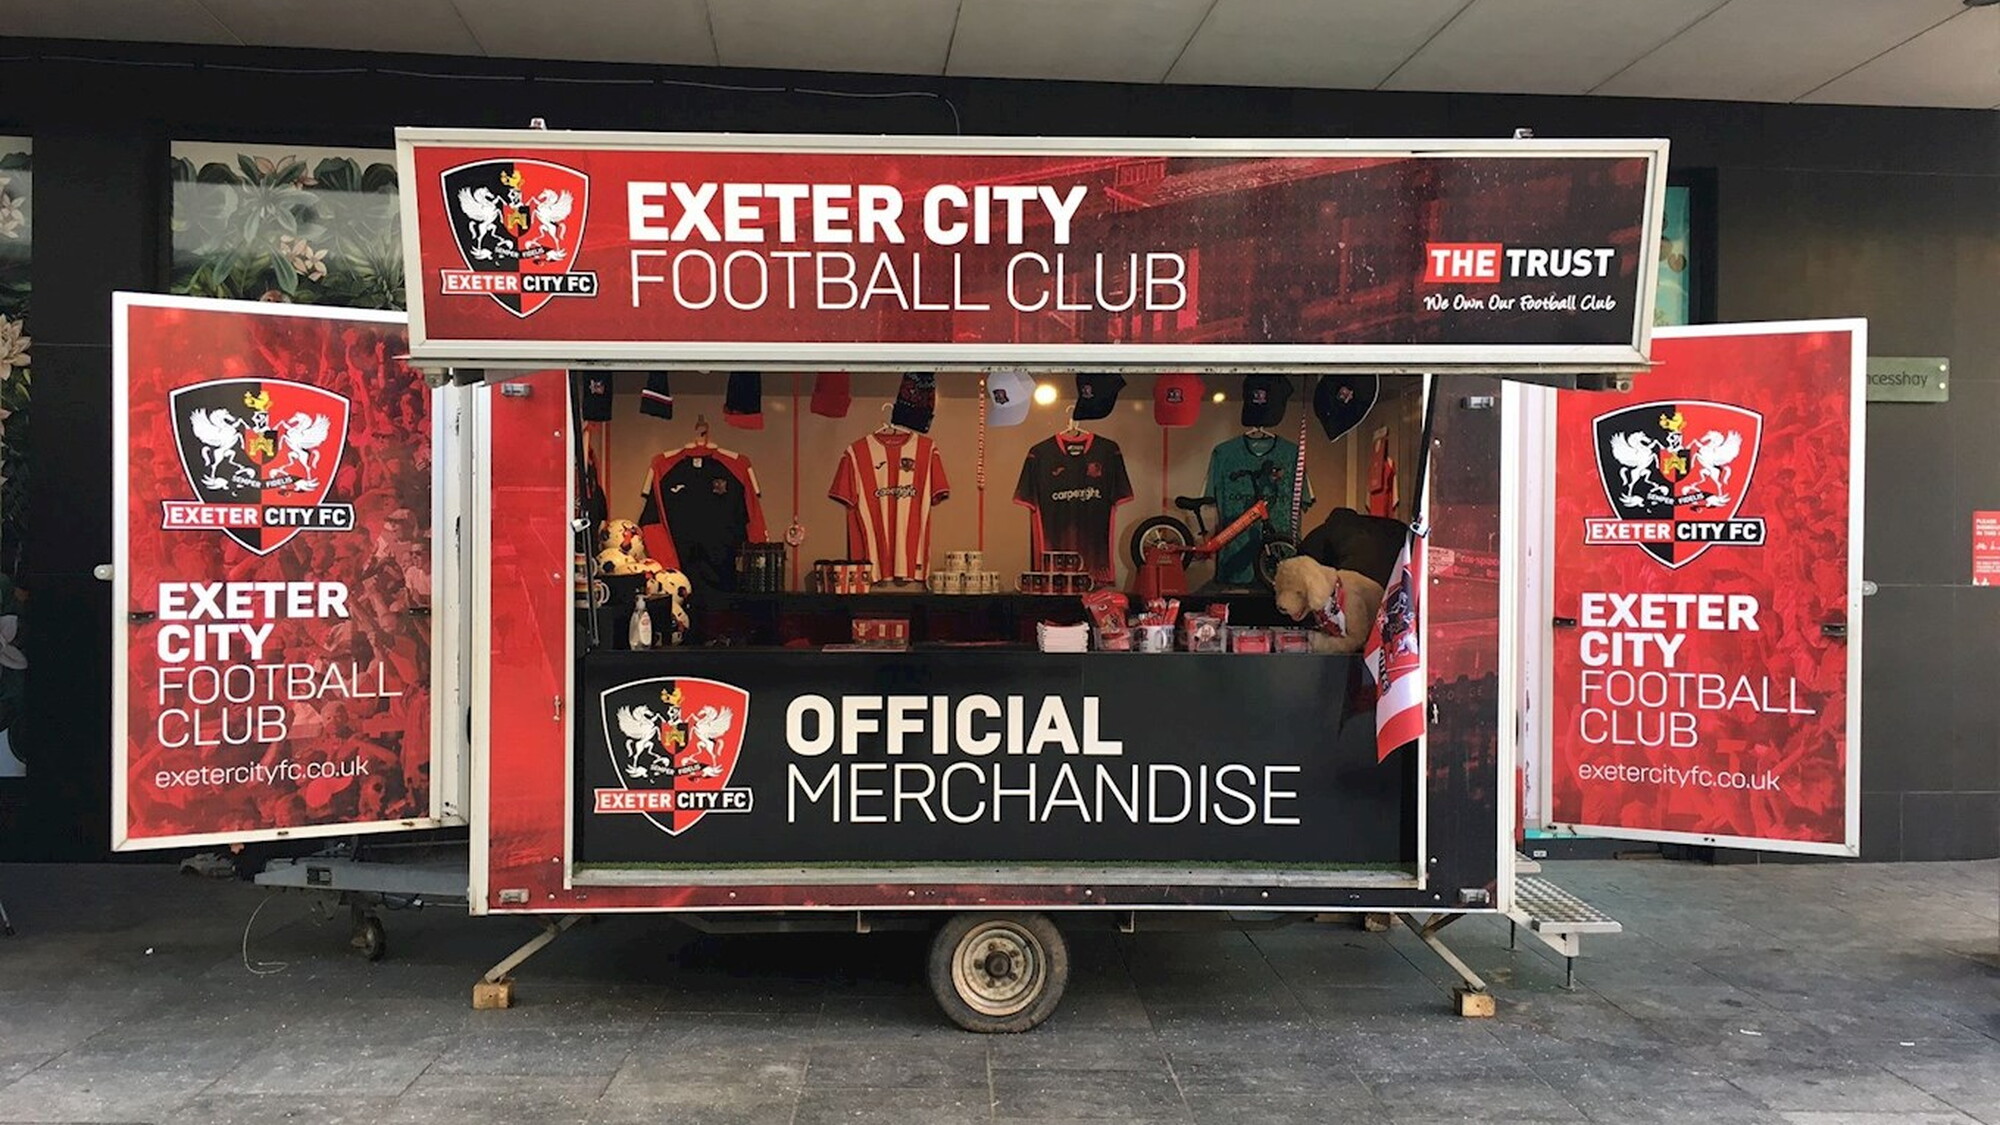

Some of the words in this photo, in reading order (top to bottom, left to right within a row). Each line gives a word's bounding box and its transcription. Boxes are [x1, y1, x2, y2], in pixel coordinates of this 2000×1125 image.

[628, 182, 904, 243] EXETER
[924, 185, 1087, 244] CITY
[632, 250, 989, 310] FOOTBALL
[1008, 252, 1186, 311] CLUB
[1432, 250, 1495, 276] THE
[1507, 249, 1614, 276] TRUST
[448, 275, 517, 289] EXETER
[524, 276, 562, 291] CITY
[568, 277, 590, 291] FC
[1424, 294, 1449, 310] We
[1454, 294, 1484, 310] Own
[1489, 295, 1515, 310] Our
[1521, 295, 1576, 310] Football
[1581, 295, 1616, 310] Club
[232, 475, 261, 488] SEMPER
[266, 476, 293, 488] FIDELIS
[171, 507, 257, 523] EXETER
[265, 508, 313, 524] CITY
[320, 509, 345, 525] FC
[1593, 524, 1670, 538] EXETER
[1678, 523, 1724, 539] CITY
[1730, 524, 1756, 539] FC
[159, 582, 348, 620] EXETER
[1582, 593, 1759, 631] EXETER
[158, 624, 271, 662] CITY
[1581, 632, 1685, 667] CITY
[159, 661, 402, 705] FOOTBALL
[1581, 671, 1815, 715] FOOTBALL
[159, 705, 286, 747] CLUB
[787, 694, 1123, 756] OFFICIAL
[1581, 709, 1697, 748] CLUB
[156, 756, 368, 787] exetercityfc.co.uk
[1579, 763, 1780, 791] exetercityfc.co.uk
[601, 794, 670, 808] EXETER
[678, 793, 718, 808] CITY
[723, 793, 745, 807] FC
[788, 762, 1300, 825] MERCHANDISE
